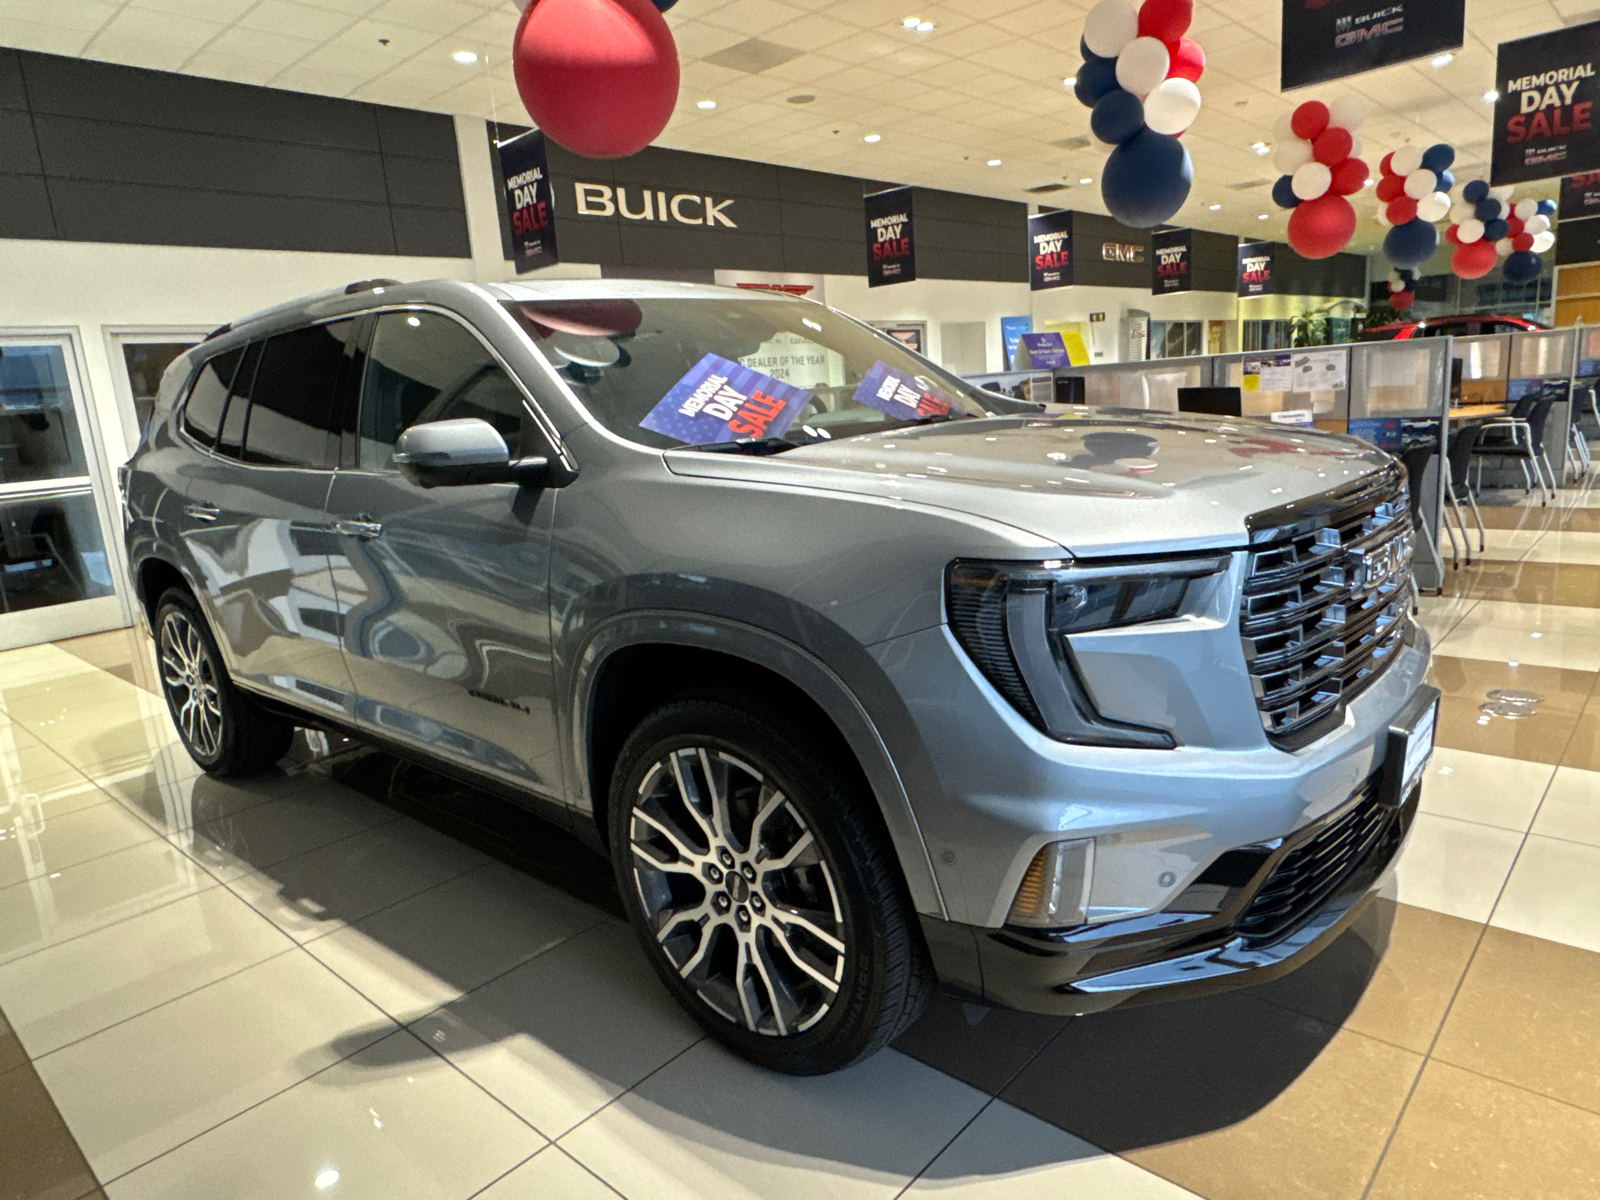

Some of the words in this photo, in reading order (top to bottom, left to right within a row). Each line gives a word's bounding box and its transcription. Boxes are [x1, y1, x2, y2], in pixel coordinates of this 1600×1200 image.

[1355, 4, 1404, 25] BUICK
[1335, 17, 1404, 49] GMC
[1507, 62, 1596, 93] MEMORIAL
[1520, 81, 1580, 114] DAY
[1506, 101, 1593, 144] SALE
[507, 167, 543, 191] MEMORIAL
[514, 182, 537, 210] DAY
[574, 182, 738, 228] BUICK
[513, 201, 548, 235] SALE
[870, 213, 908, 229] MEMORIAL
[877, 224, 902, 242] DAY
[1033, 231, 1069, 244] MEMORIAL
[872, 237, 910, 262] SALE
[1040, 239, 1063, 255] DAY
[1102, 242, 1144, 263] GMC
[1034, 251, 1069, 270] SALE
[1157, 261, 1187, 277] SALE
[1161, 252, 1182, 265] DAY
[1246, 261, 1266, 273] DAY
[1242, 269, 1271, 283] SALE
[747, 357, 778, 368] DEALER
[780, 357, 789, 366] OF
[791, 356, 805, 365] THE
[806, 355, 825, 365] YEAR
[770, 368, 790, 379] 2024
[678, 374, 728, 417] MEMORIAL
[702, 385, 748, 421] DAY
[893, 384, 921, 408] DAY
[727, 390, 787, 439] SALE
